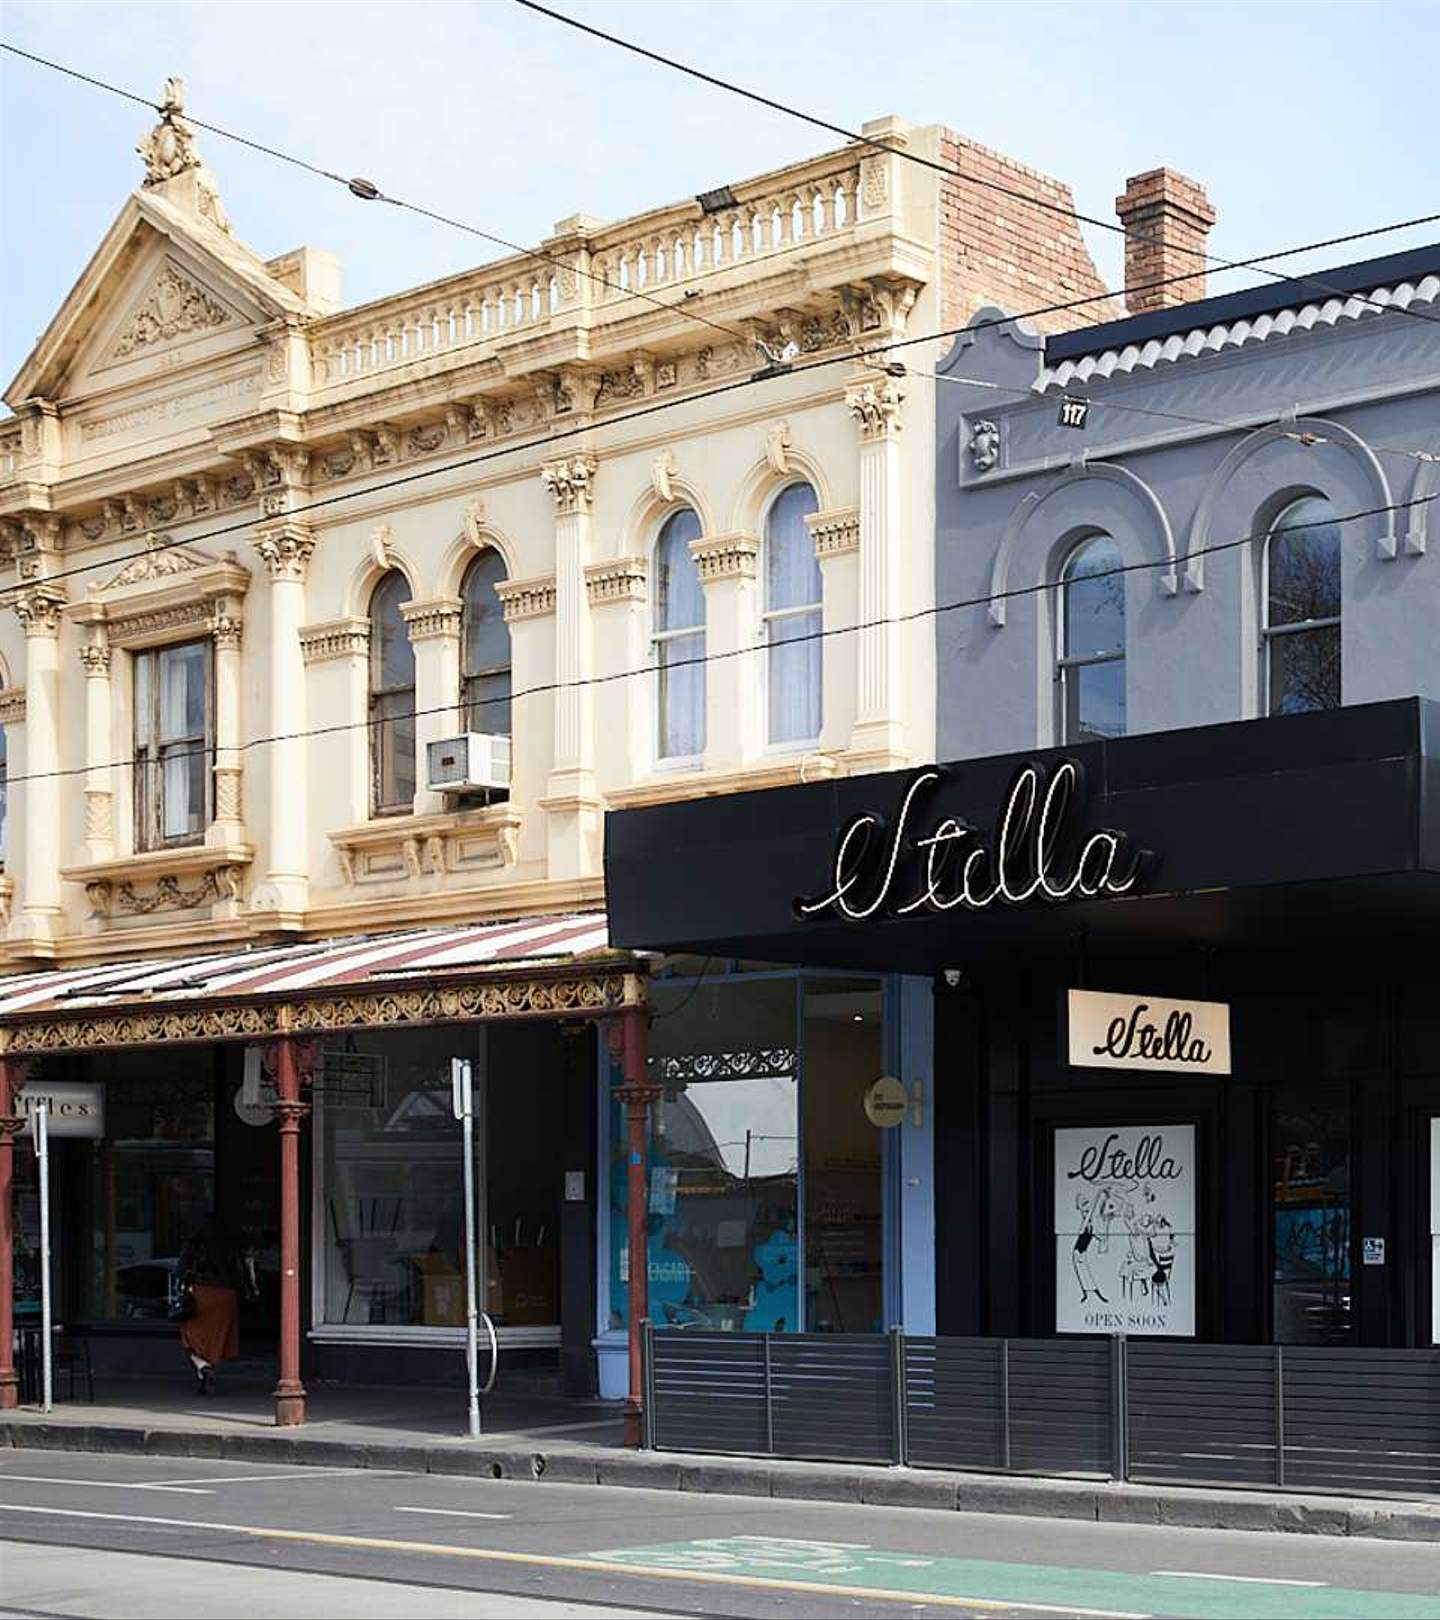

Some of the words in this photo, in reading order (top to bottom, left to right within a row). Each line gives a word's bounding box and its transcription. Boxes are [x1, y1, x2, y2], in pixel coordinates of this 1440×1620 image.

[1063, 404, 1086, 425] 117
[798, 763, 1152, 919] Stella
[1093, 1004, 1212, 1063] Stella
[1067, 1134, 1183, 1180] Stella
[1084, 1313, 1124, 1327] OPEN
[1127, 1313, 1167, 1328] SOON
